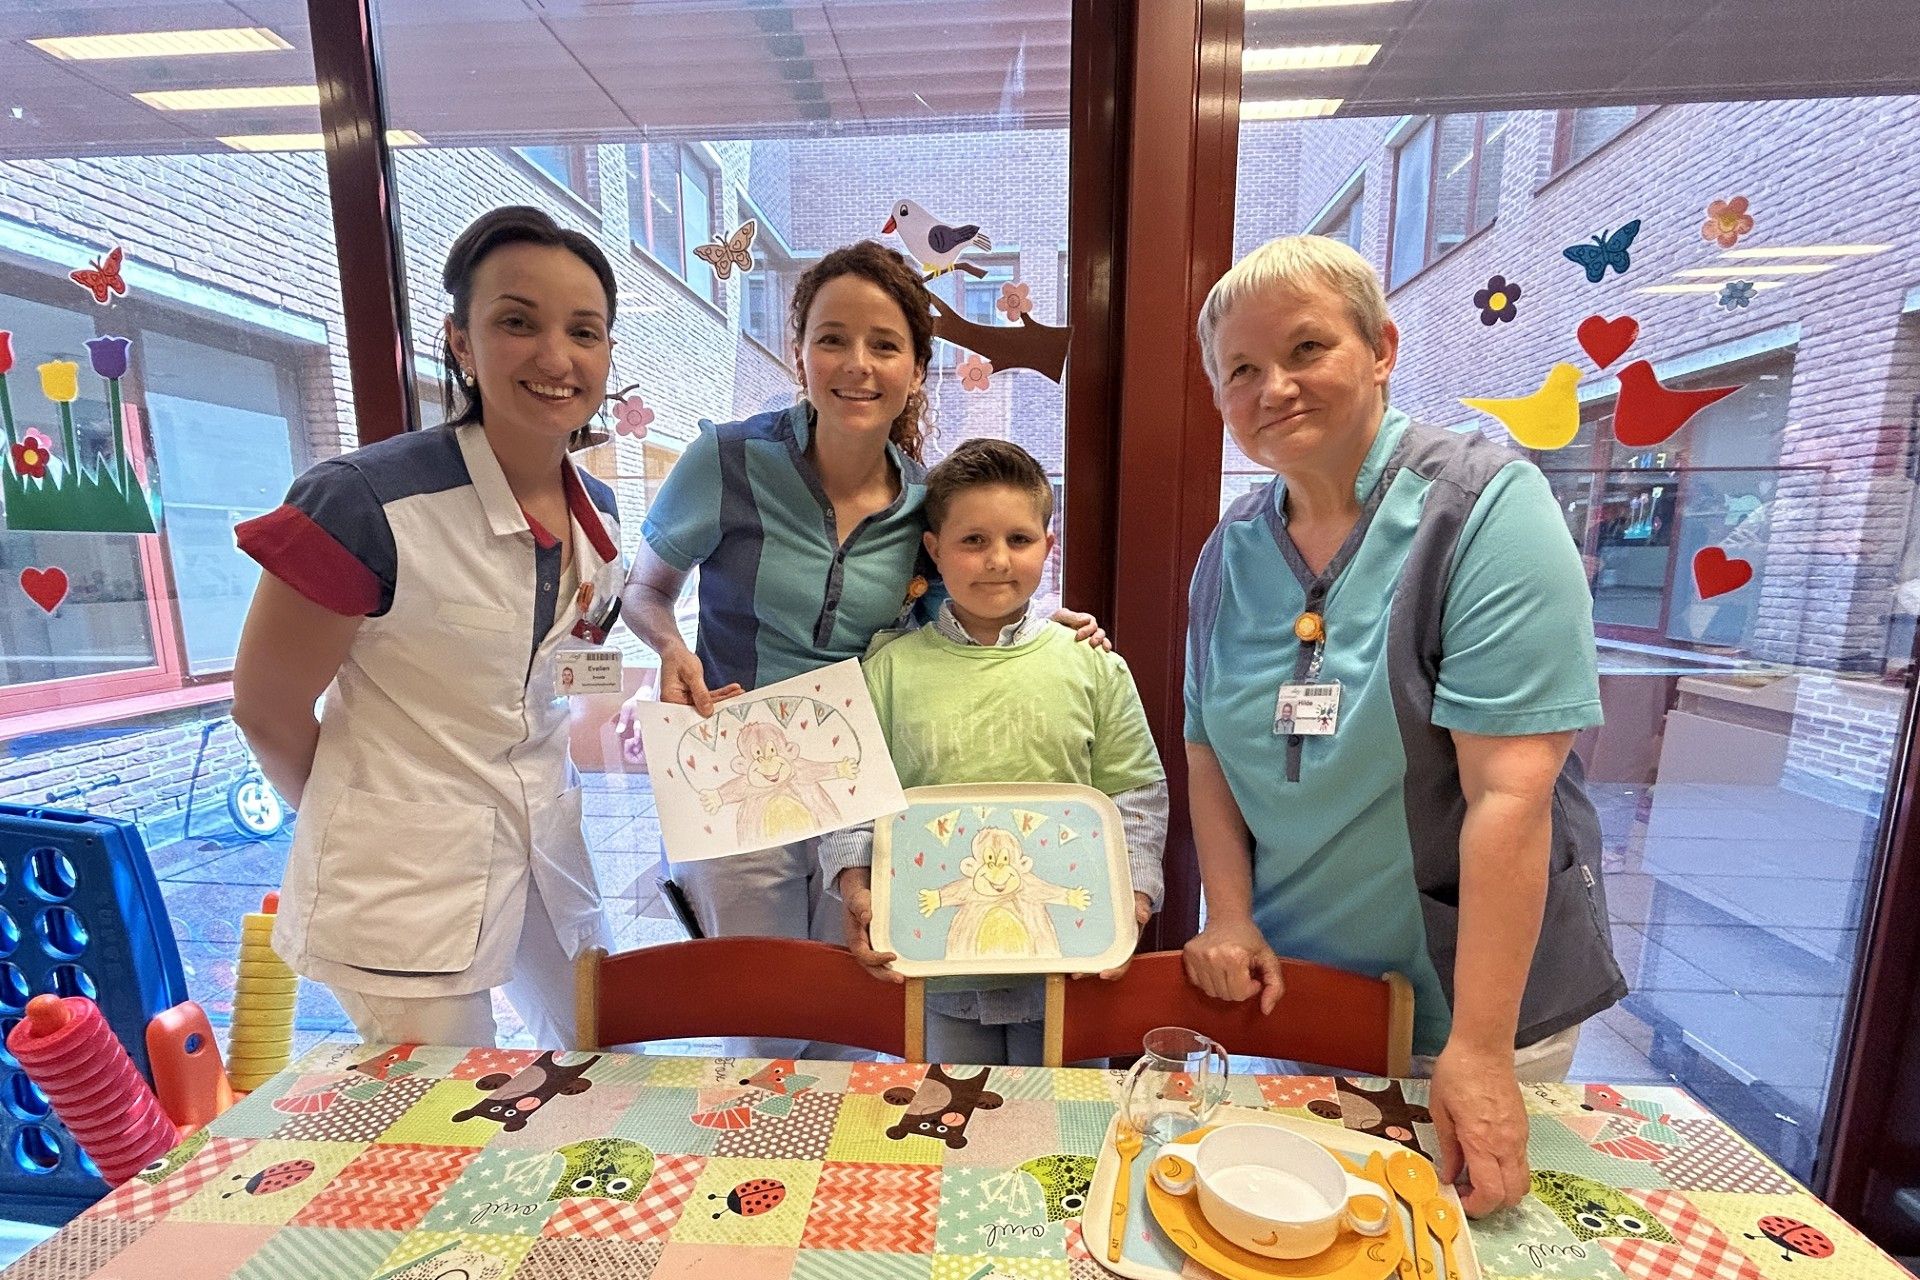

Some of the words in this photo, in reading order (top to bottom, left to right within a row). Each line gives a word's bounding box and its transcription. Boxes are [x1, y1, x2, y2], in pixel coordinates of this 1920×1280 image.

[469, 1202, 538, 1225] owl
[983, 1223, 1045, 1248] owl
[1517, 1243, 1586, 1269] owl
